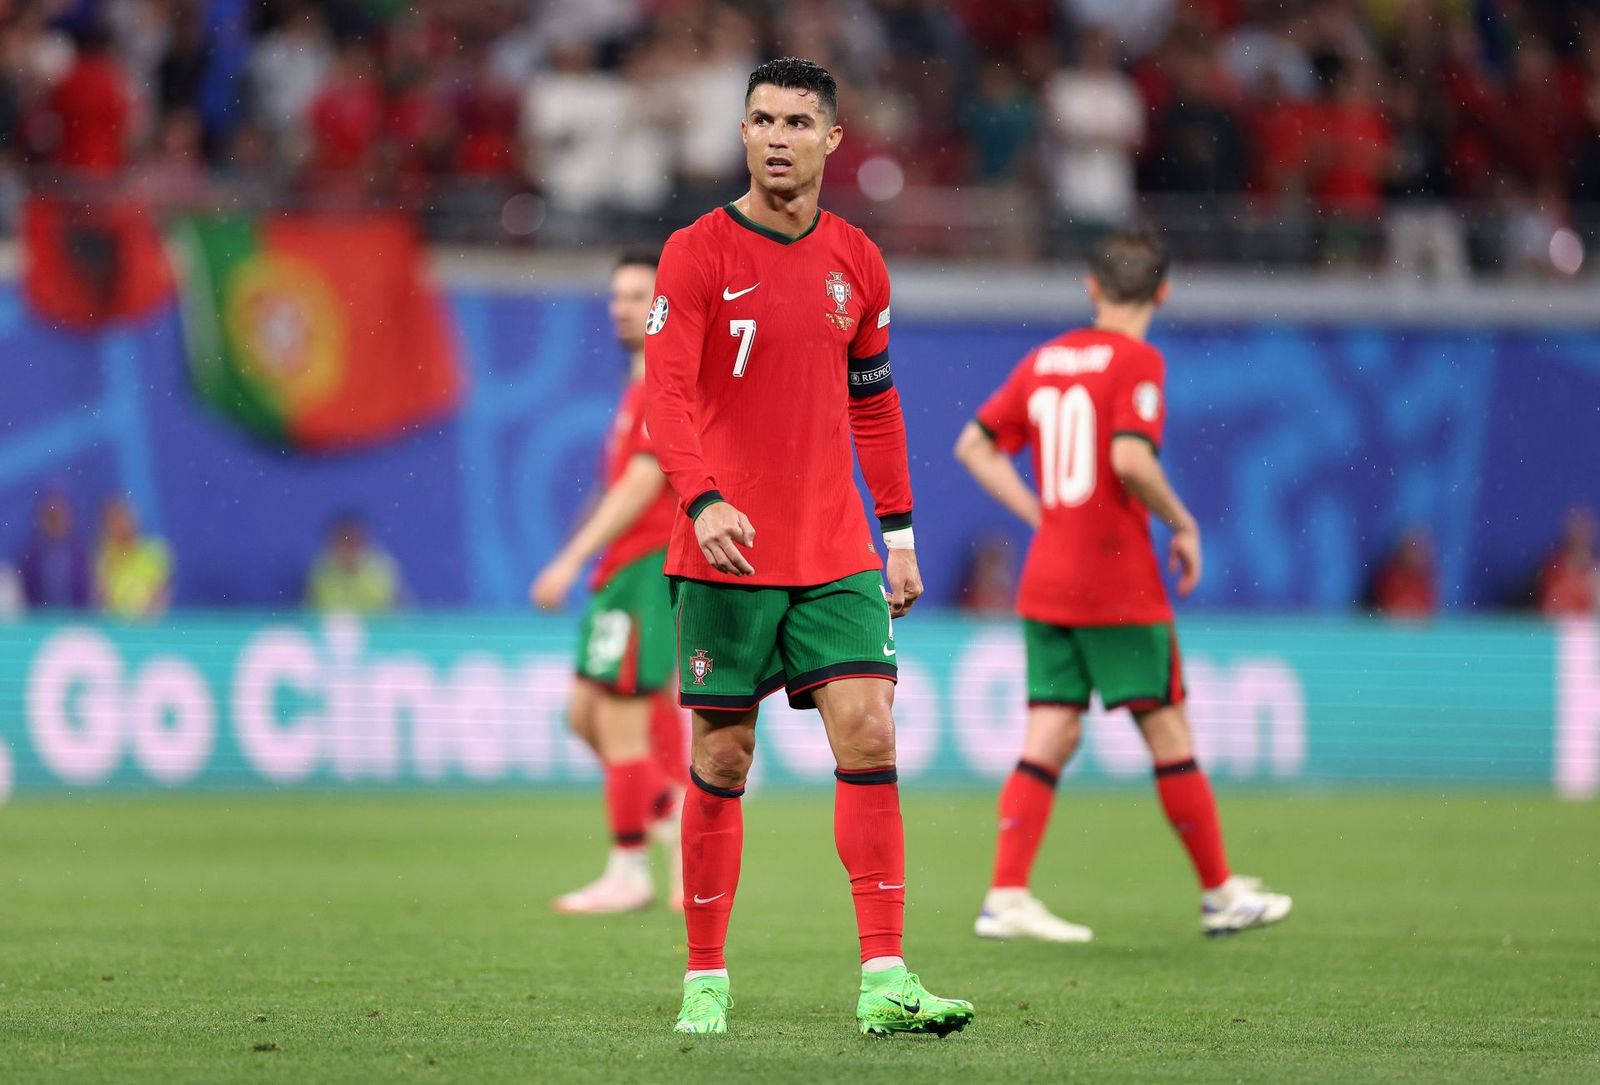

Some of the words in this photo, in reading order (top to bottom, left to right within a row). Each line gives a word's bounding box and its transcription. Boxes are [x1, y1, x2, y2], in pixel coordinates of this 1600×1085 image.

[729, 319, 757, 377] 7
[1028, 385, 1098, 509] 10
[29, 624, 214, 785] Go
